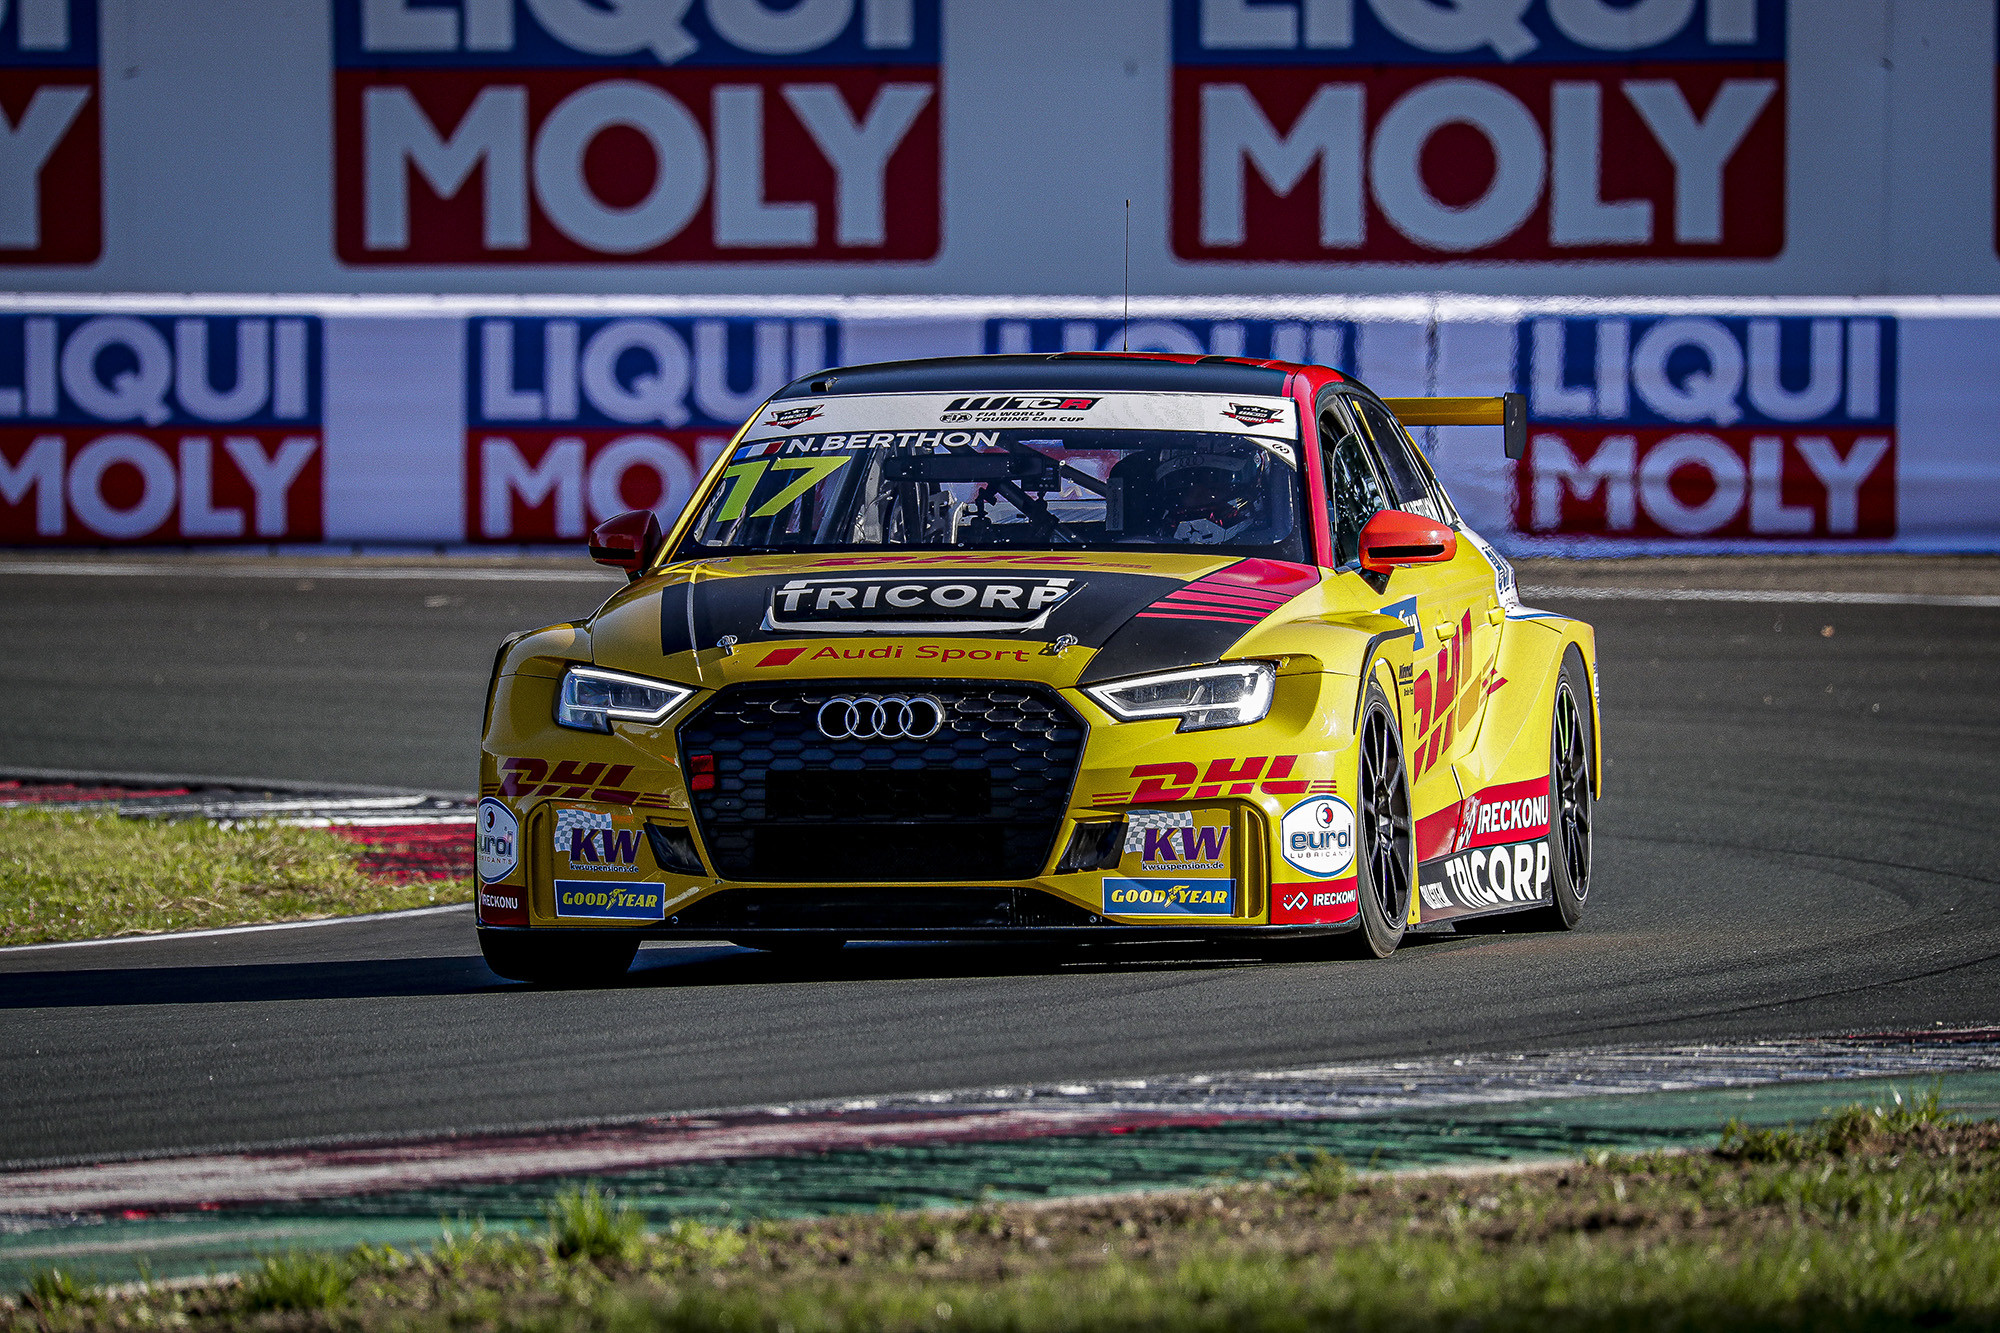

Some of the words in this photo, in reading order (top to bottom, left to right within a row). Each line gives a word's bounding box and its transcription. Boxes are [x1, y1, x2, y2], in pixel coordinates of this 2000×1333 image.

[363, 79, 934, 254] MOLY
[1200, 77, 1778, 252] MOLY
[1532, 316, 1880, 426] LIQUI
[941, 412, 972, 423] FIA
[786, 432, 1000, 454] N.BERTHON
[716, 455, 852, 522] 17
[1532, 433, 1890, 537] MOLY
[805, 555, 1095, 566] DHL
[776, 584, 1069, 611] TRICORP
[810, 645, 904, 660] Audi
[915, 645, 1030, 662] Sport
[499, 757, 641, 804] DHL
[1128, 755, 1311, 803] DHL
[1476, 795, 1549, 835] IRECKONU
[570, 828, 645, 864] KW
[1141, 825, 1231, 864] KW
[1290, 823, 1351, 851] eurol
[570, 860, 640, 873] kwsuspensions.de
[1141, 861, 1225, 872] kwsuspensions.de
[1445, 842, 1550, 909] TRICORP
[1313, 889, 1357, 906] IRECKONU
